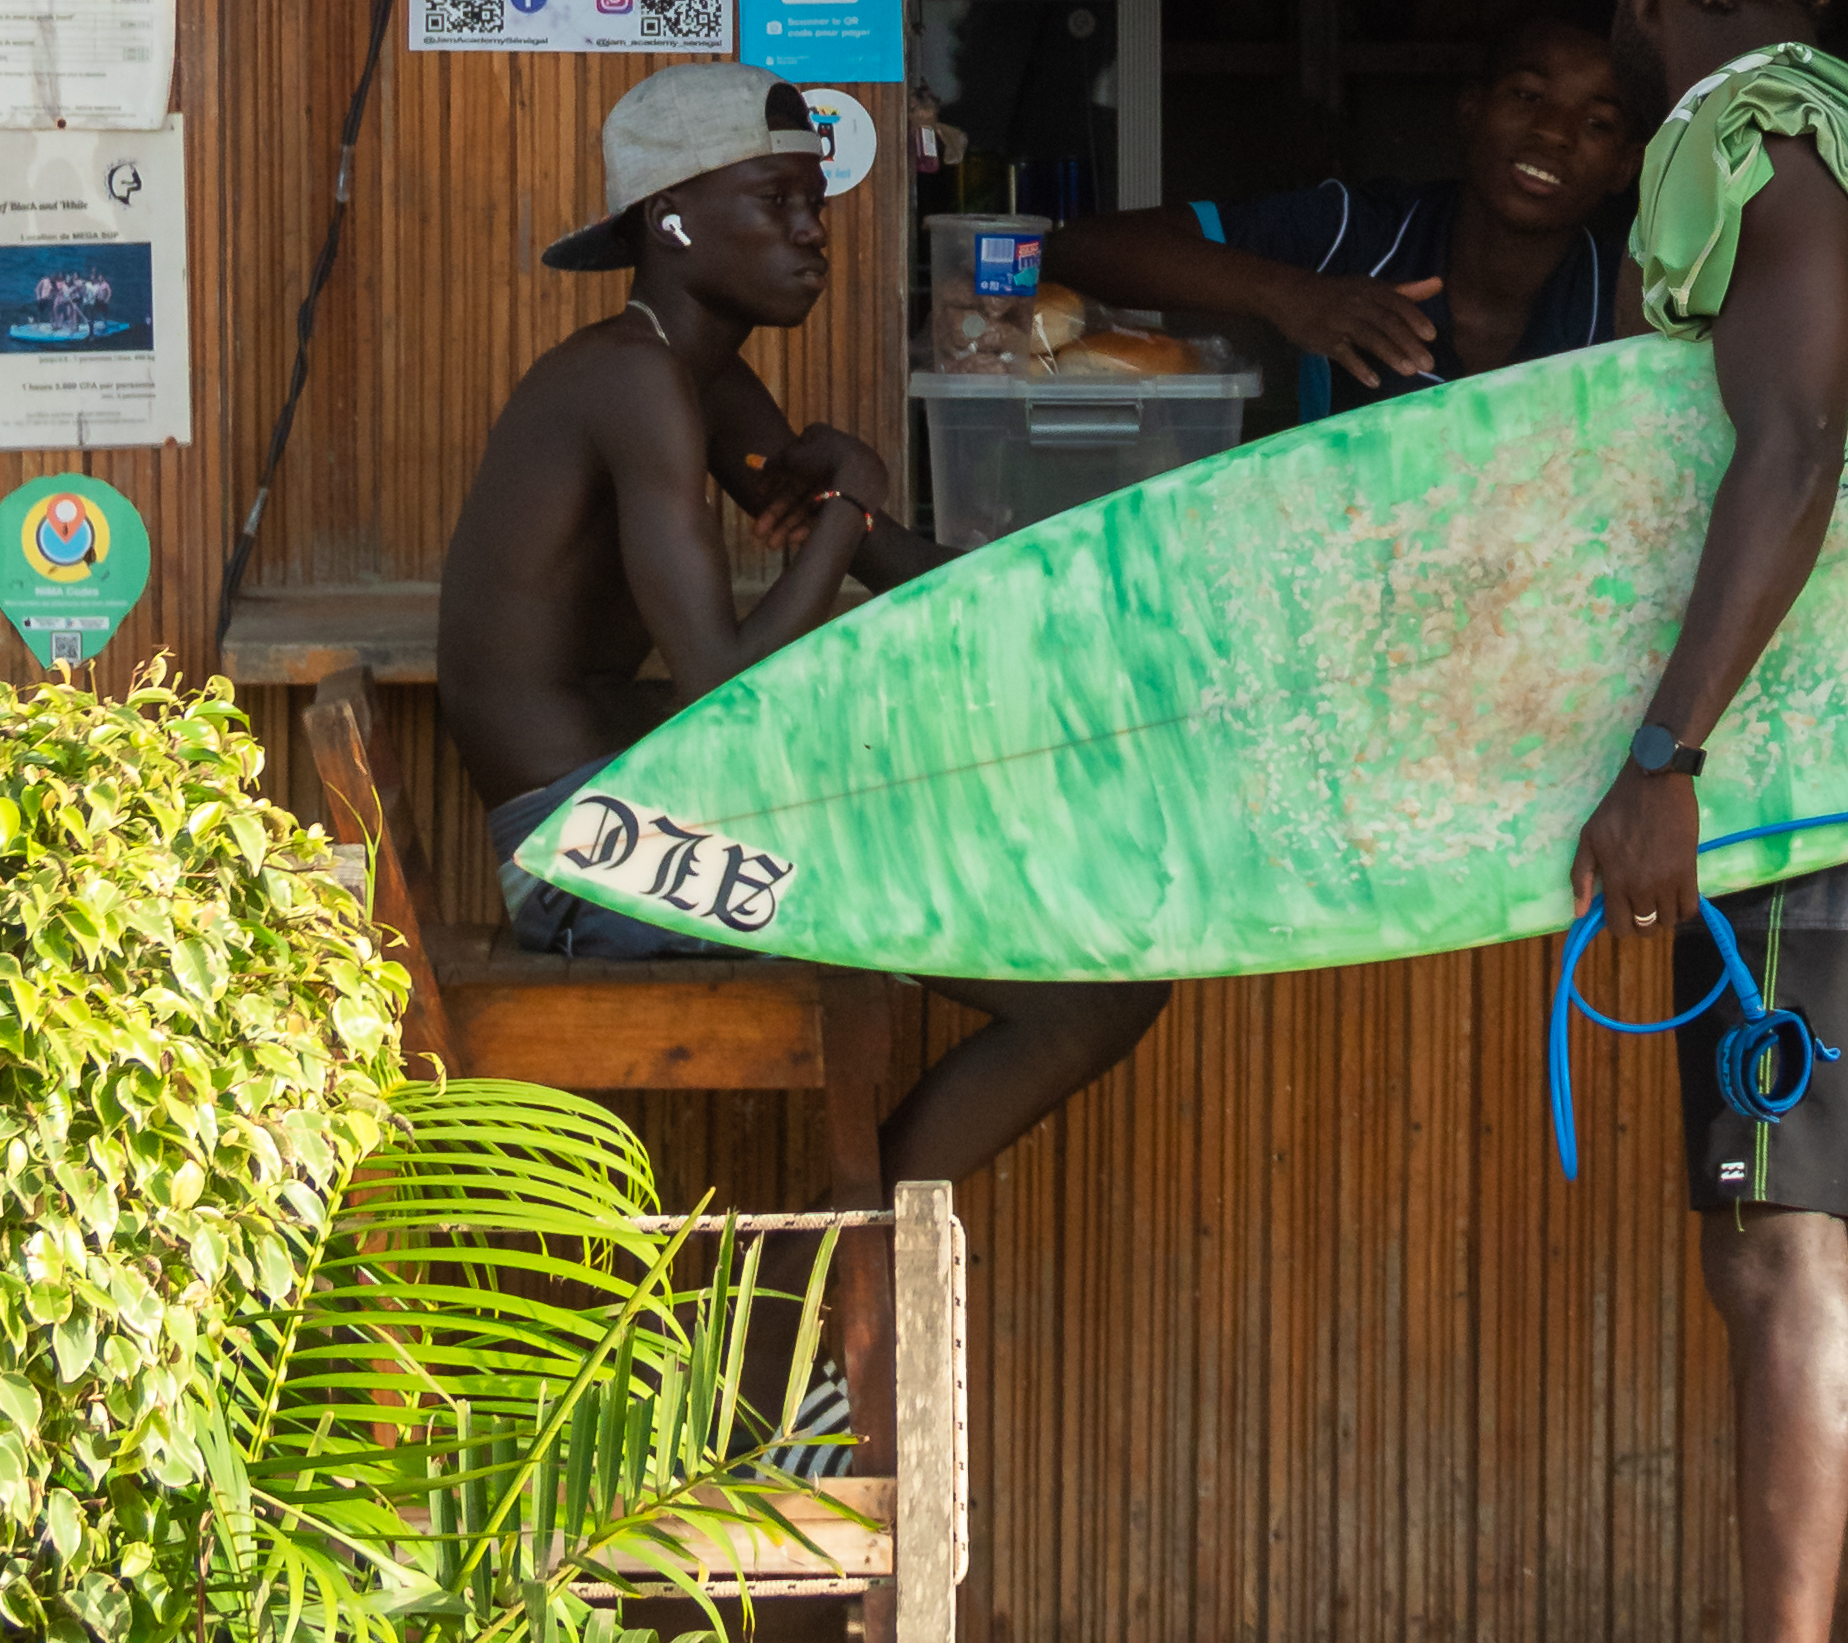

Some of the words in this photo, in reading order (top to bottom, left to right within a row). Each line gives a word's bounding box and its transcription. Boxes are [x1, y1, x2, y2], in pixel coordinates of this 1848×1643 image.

[844, 17, 859, 26] QR
[10, 200, 37, 212] Black
[39, 200, 57, 211] and
[60, 199, 88, 210] White
